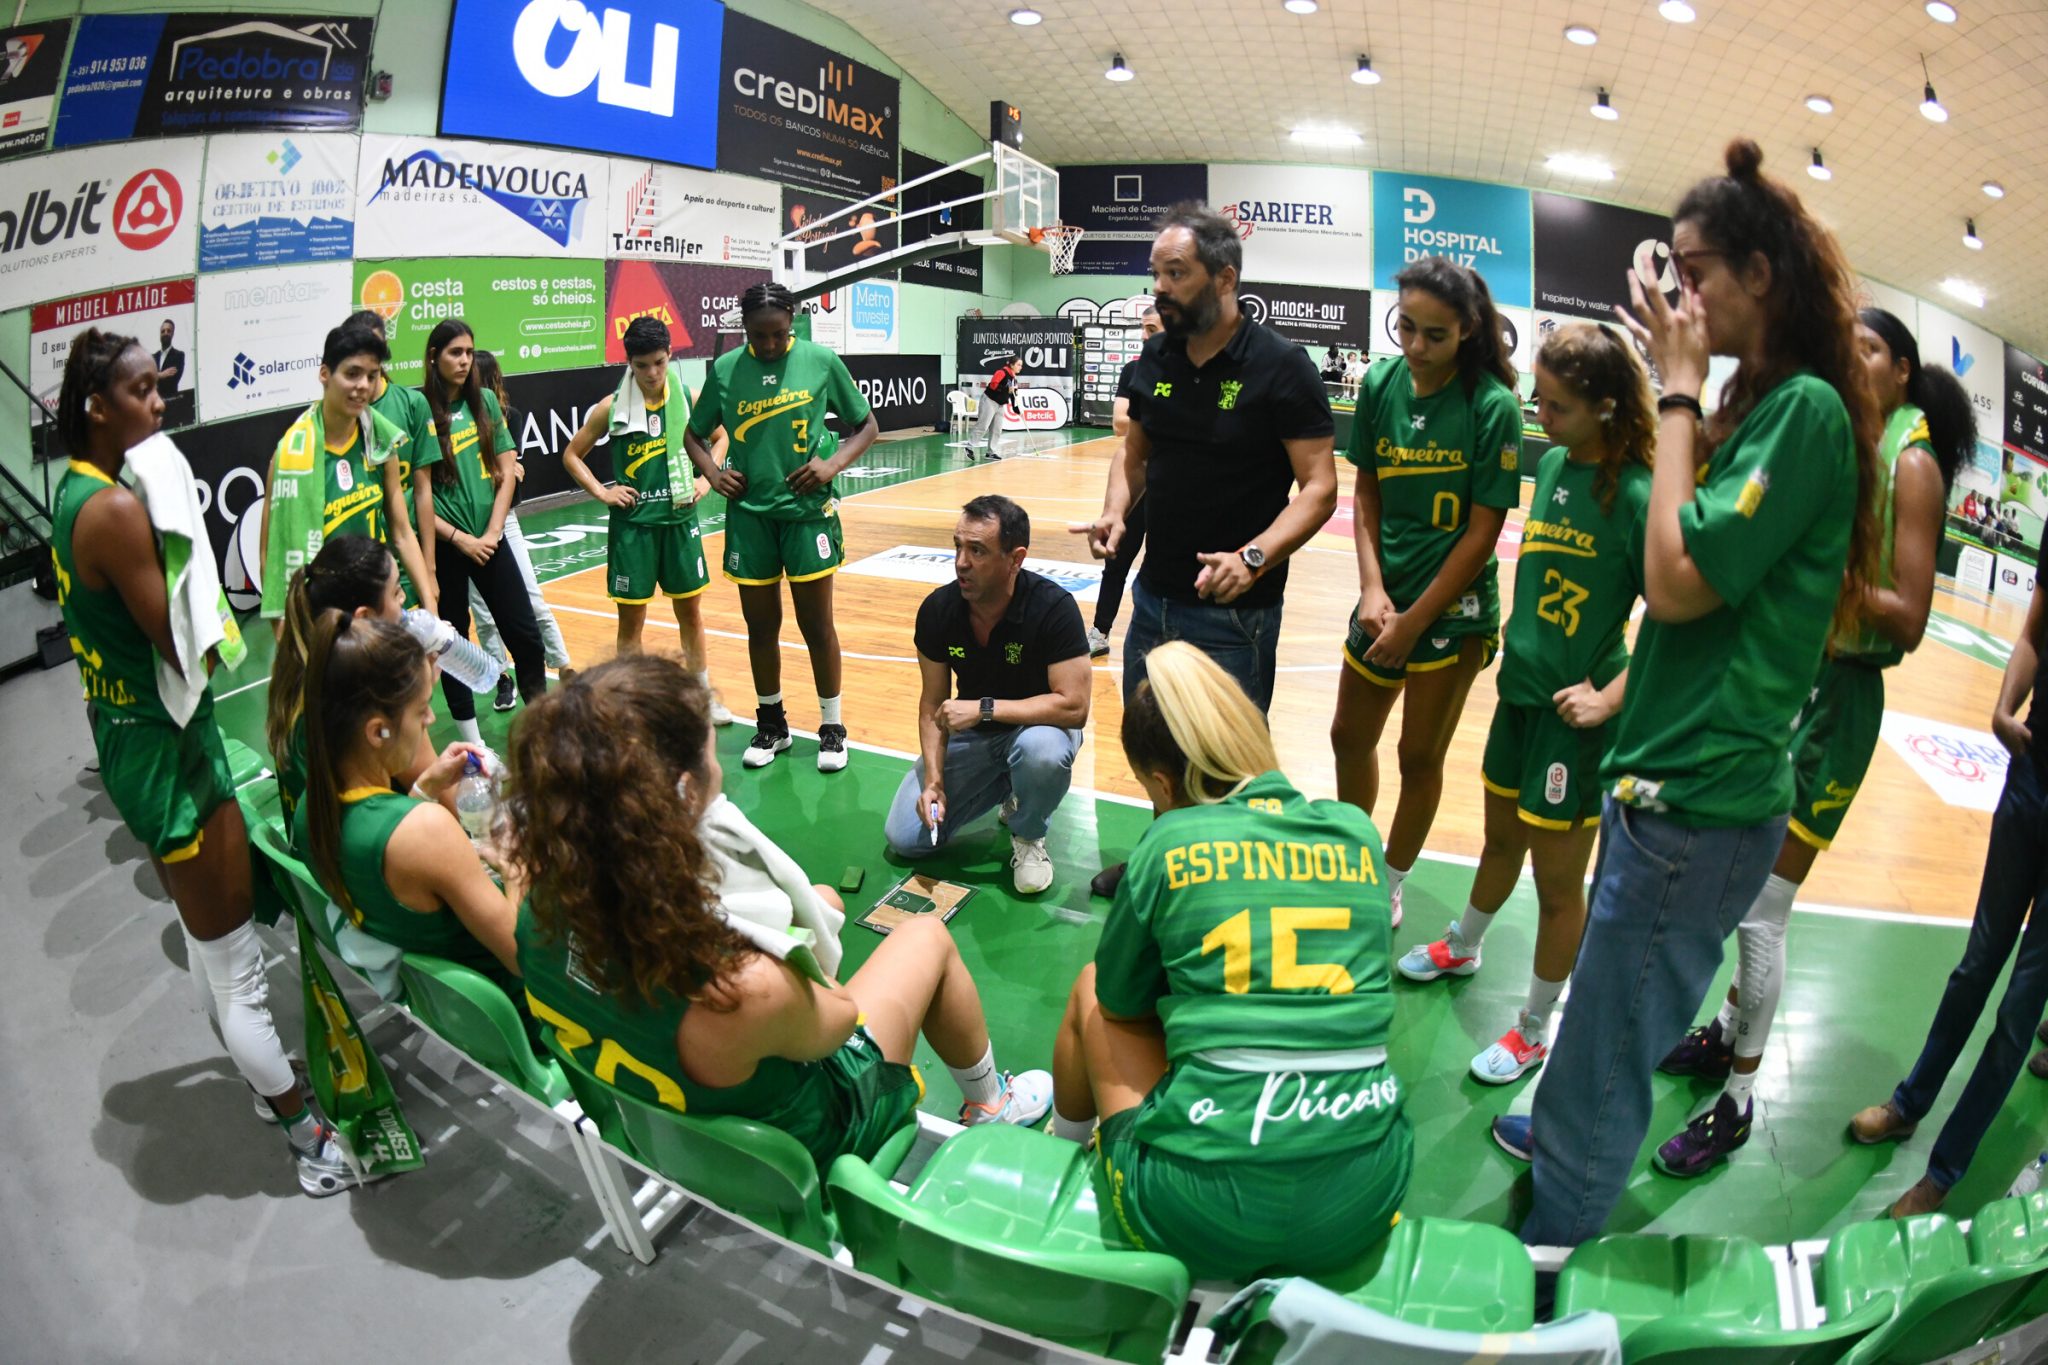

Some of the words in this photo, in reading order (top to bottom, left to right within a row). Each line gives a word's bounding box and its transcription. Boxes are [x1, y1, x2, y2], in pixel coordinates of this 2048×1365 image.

[90, 60, 108, 74] 914
[109, 58, 127, 72] 953
[128, 56, 147, 70] 036
[178, 47, 321, 81] Pedobra
[165, 86, 272, 104] arquitetura
[283, 89, 292, 98] e
[303, 87, 351, 100] obras
[733, 104, 768, 122] TODOS
[769, 114, 783, 127] OS
[785, 119, 821, 138] BANCOS
[822, 131, 846, 145] NUMA
[859, 142, 890, 159] AGÊNCIA
[215, 180, 300, 200] OBJETIVO
[311, 179, 346, 196] 100%
[379, 188, 455, 202] madeiras
[462, 193, 482, 204] s.a.
[213, 202, 261, 217] CENTRO
[268, 201, 283, 212] DE
[291, 199, 345, 212] ESTUDOS
[684, 194, 704, 204] Apoio
[716, 197, 745, 209] desporto
[751, 203, 776, 214] cultura!
[1092, 205, 1126, 213] Macieira
[1128, 204, 1139, 213] de
[1141, 204, 1169, 213] Castro
[1239, 200, 1333, 226] SARIFER
[613, 233, 703, 259] TorreAlfer
[1404, 227, 1502, 254] HOSPITAL
[52, 246, 97, 262] EXPERTS
[935, 261, 952, 272] PORTAS
[956, 266, 978, 277] FACHADAS
[411, 278, 464, 298] cesta
[492, 277, 537, 291] cestos
[540, 279, 548, 289] e
[552, 276, 596, 291] cestas,
[56, 298, 109, 325] MIGUEL
[117, 286, 168, 313] ATAÍDE
[533, 290, 548, 305] só
[552, 291, 596, 305] cheios.
[702, 297, 710, 310] O
[713, 295, 739, 310] CAFÉ
[856, 286, 890, 307] Metro
[1542, 291, 1575, 305] Inspired
[1576, 298, 1587, 308] by
[411, 298, 464, 320] cheia
[856, 306, 890, 325] investe
[1271, 301, 1345, 321] KNOCK-OUT
[525, 319, 591, 331] www.cestacheia.pt
[702, 314, 717, 327] DA
[1299, 321, 1318, 329] FITNESS
[51, 341, 66, 352] seu
[972, 333, 999, 345] JUNTOS
[1000, 333, 1043, 345] MARCAMOS
[1044, 333, 1074, 345] PONTOS
[1025, 346, 1067, 368] OLI
[736, 388, 811, 416] Esgueira
[1027, 411, 1054, 420] Betclic
[792, 419, 809, 453] 3
[1537, 568, 1590, 637] 23
[1164, 841, 1379, 890] ESPINDOLA
[1201, 907, 1356, 994] 15
